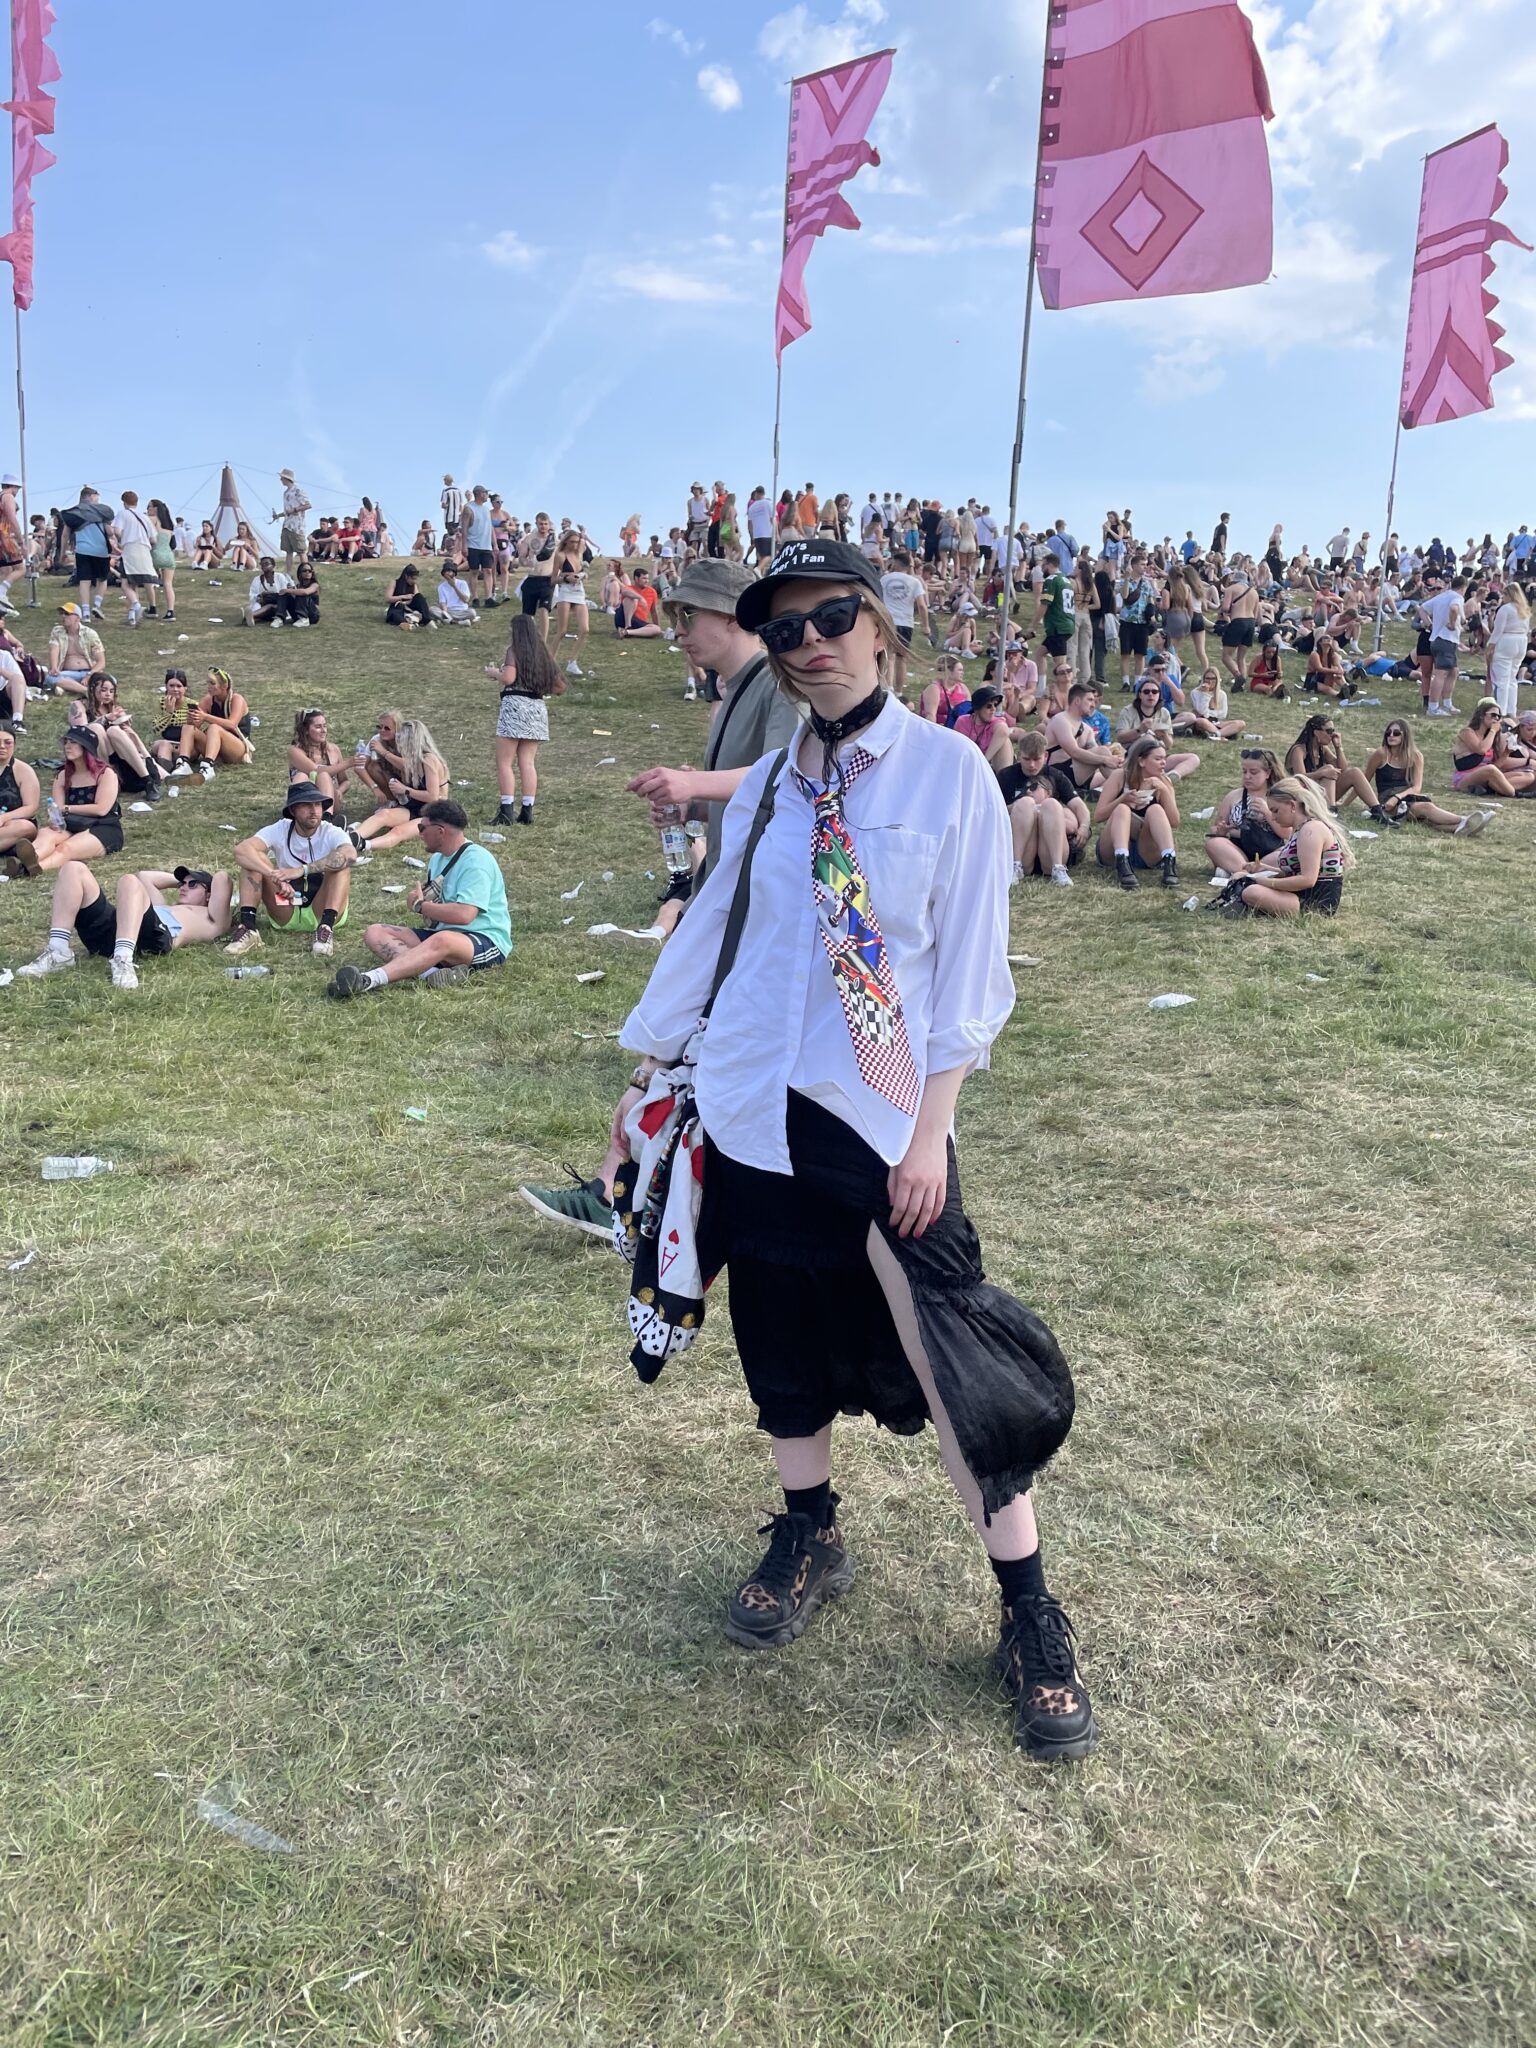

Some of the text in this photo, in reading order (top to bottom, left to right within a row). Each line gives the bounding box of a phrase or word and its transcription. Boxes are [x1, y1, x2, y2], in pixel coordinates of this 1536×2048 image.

[791, 554, 798, 565] 1
[801, 553, 825, 564] Fan
[660, 1246, 679, 1278] A
